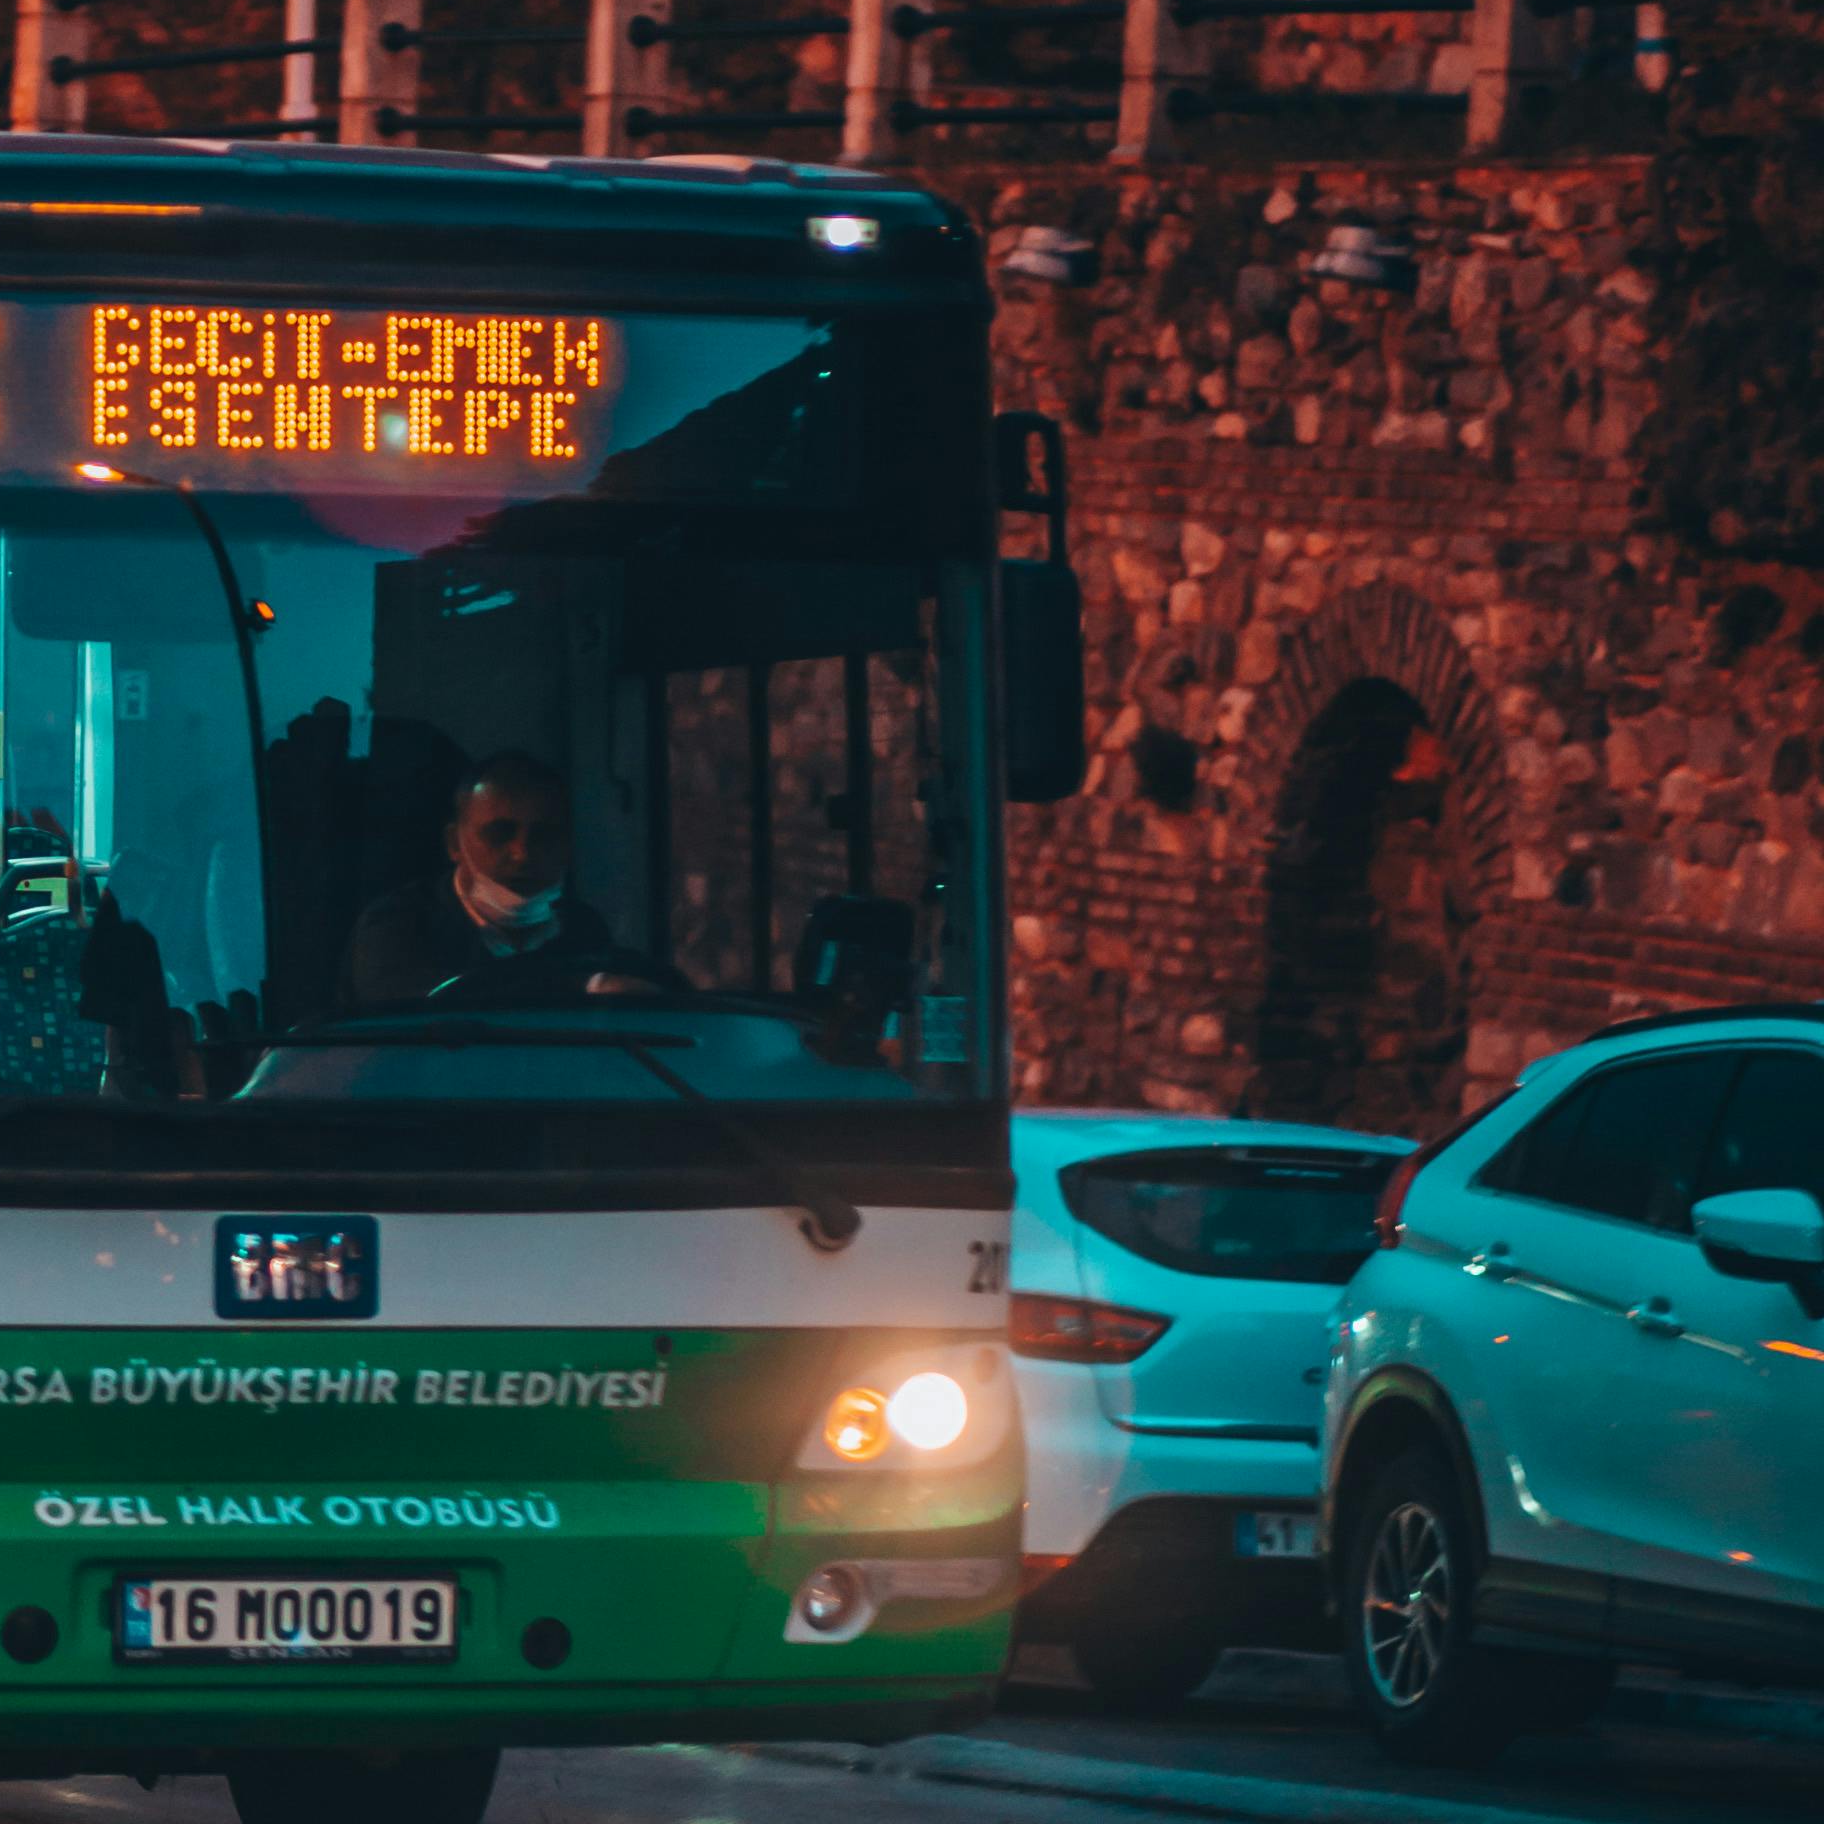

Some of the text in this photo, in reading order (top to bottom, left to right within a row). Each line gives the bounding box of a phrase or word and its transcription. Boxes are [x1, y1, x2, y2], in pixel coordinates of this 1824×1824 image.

[92, 377, 576, 457] ESENTEPE
[90, 1358, 400, 1413] BÜYÜKŞEHİR
[413, 1361, 667, 1407] BELEDİYESİ
[34, 1489, 560, 1529] ÖZEL HALK OTOBÜSÜ
[157, 1586, 217, 1642] 16
